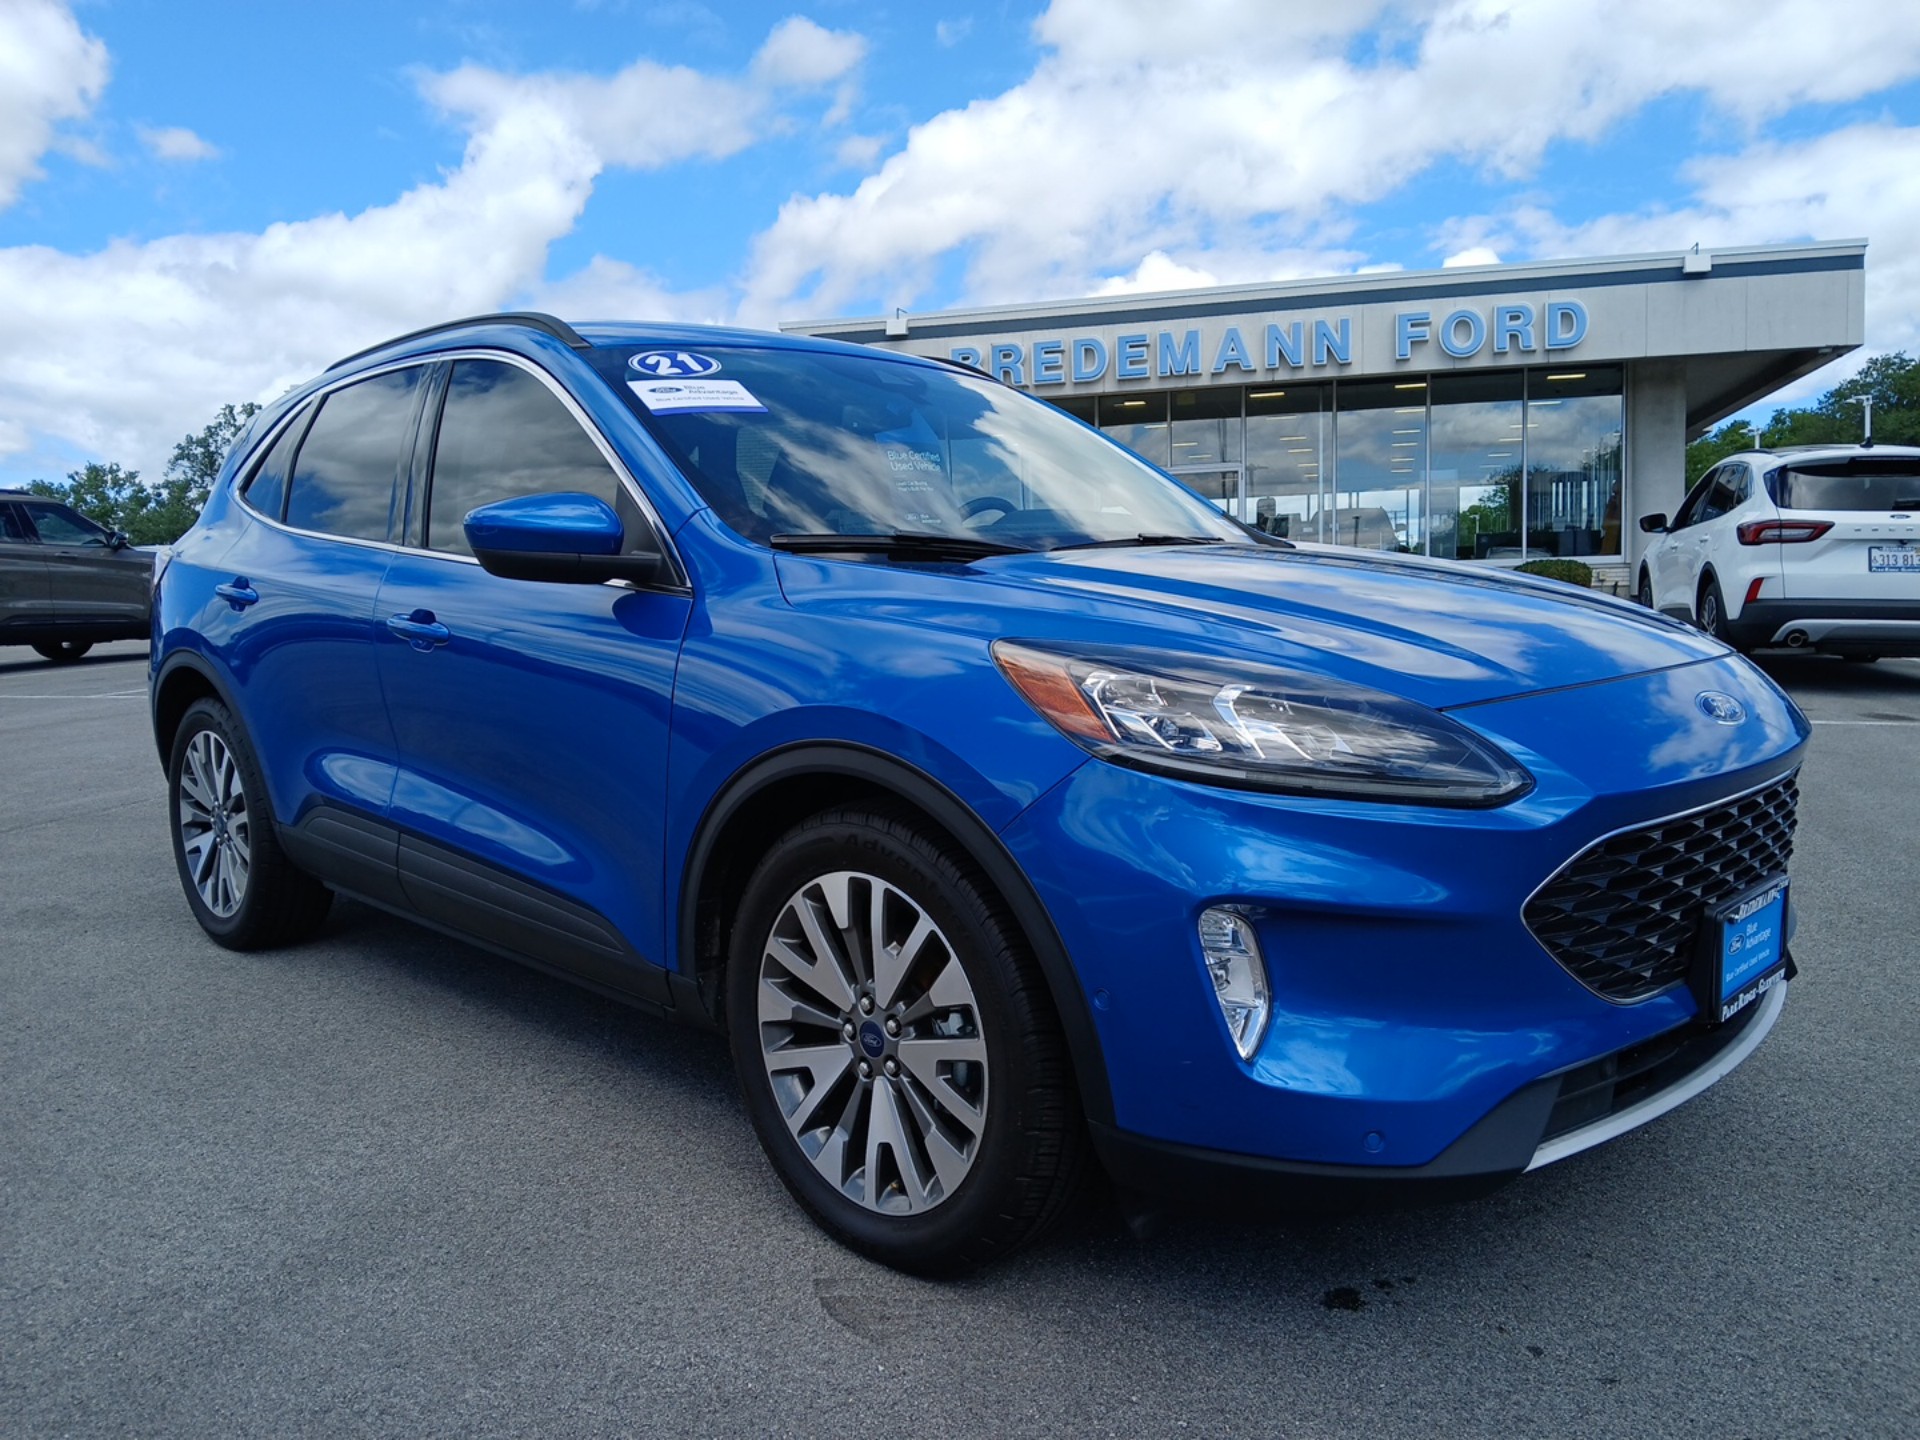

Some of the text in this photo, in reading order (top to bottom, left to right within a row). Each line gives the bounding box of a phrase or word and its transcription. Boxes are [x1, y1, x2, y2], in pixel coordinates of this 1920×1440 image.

[1396, 298, 1590, 360] FORD
[645, 352, 704, 375] 21
[1879, 554, 1898, 566] 313
